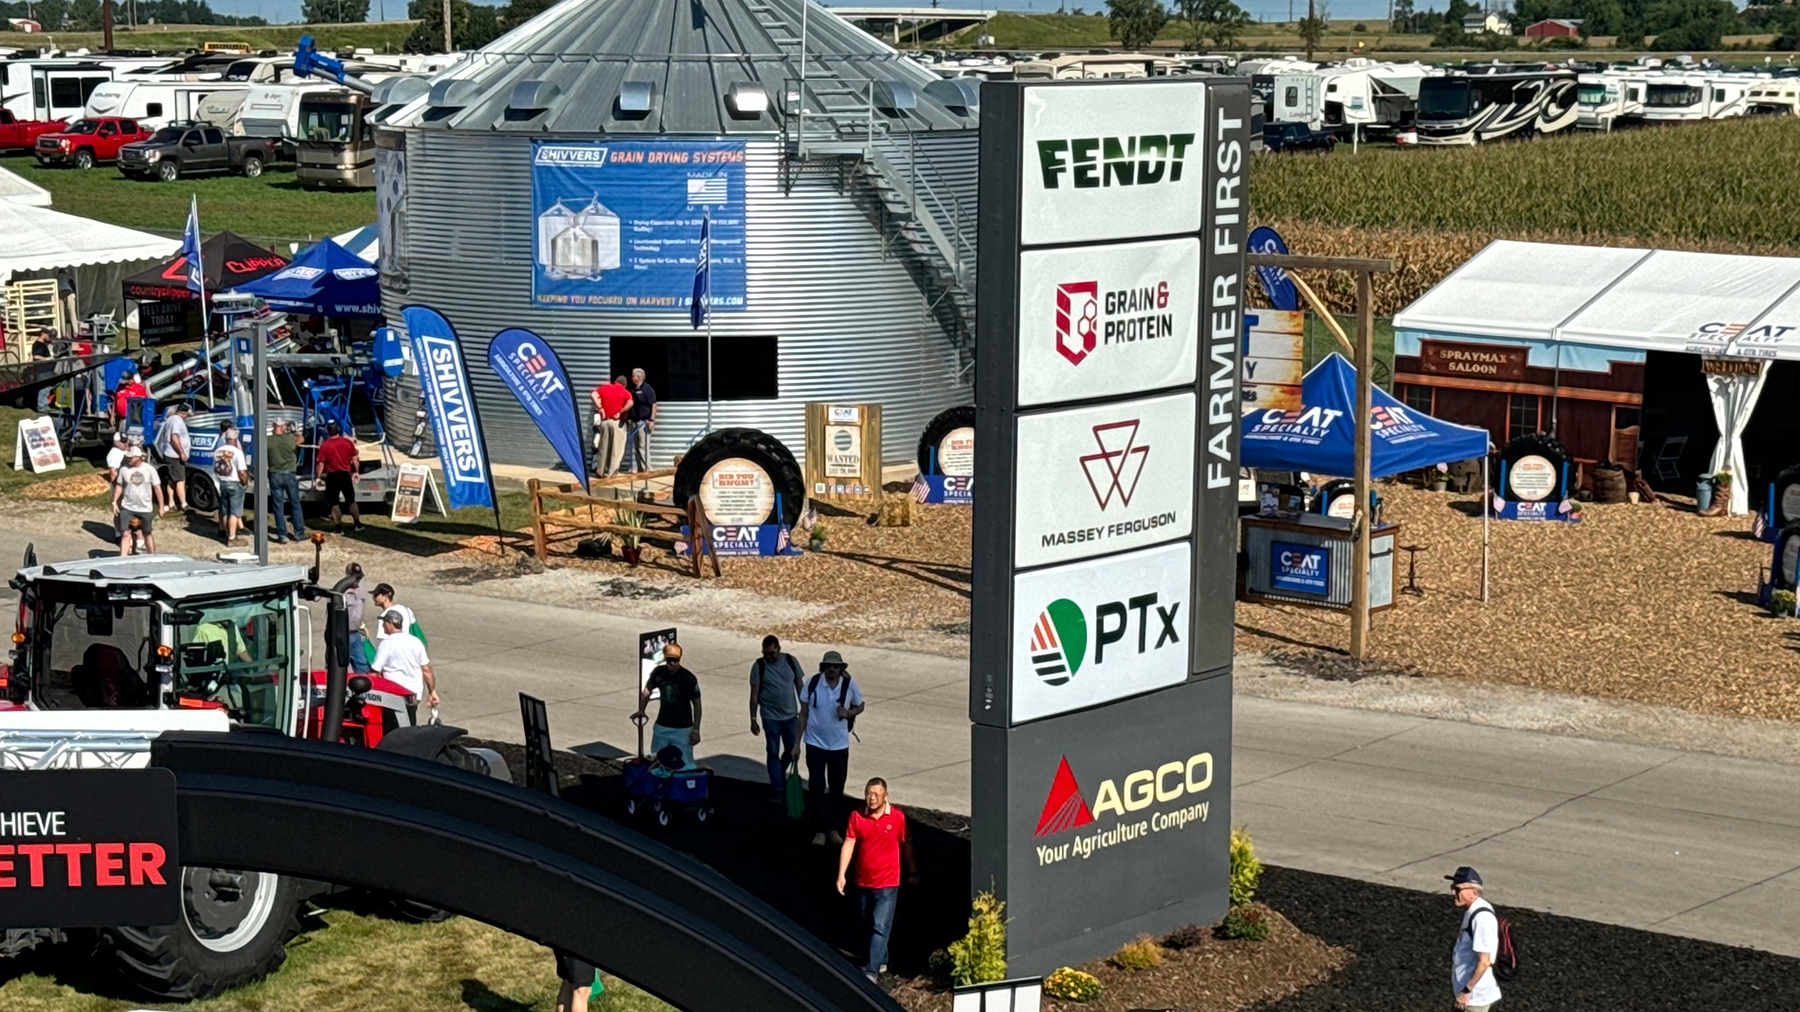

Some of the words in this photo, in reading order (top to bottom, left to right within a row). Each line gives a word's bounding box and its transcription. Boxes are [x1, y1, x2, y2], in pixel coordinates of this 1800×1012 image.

[541, 149, 600, 161] SHIVVERS
[610, 151, 644, 163] GRAIN
[648, 151, 688, 163] DRYING
[692, 151, 744, 163] SYSTEMS
[1036, 133, 1195, 189] FENDT
[1214, 107, 1242, 255] FIRST
[225, 256, 287, 273] CLIPPER
[537, 295, 568, 303] KEEPING
[570, 295, 586, 304] YOU
[588, 296, 623, 304] FOCUSED
[626, 296, 636, 304] ON
[639, 296, 676, 305] HARVEST
[142, 304, 159, 316] TEST
[161, 302, 182, 314] DRIVE
[151, 314, 174, 325] TODAY
[1104, 313, 1173, 345] PROTEIN
[1699, 322, 1797, 337] CEAT
[1440, 350, 1507, 363] SPRAYMAX
[508, 352, 549, 401] SPECIALTY
[517, 342, 565, 395] CEAT
[1448, 362, 1497, 374] SALOON
[1207, 273, 1238, 489] FARMER
[432, 347, 477, 472] SHIVVERS
[1262, 406, 1343, 429] CEAT
[1251, 424, 1330, 438] SPECIALTY
[1375, 424, 1429, 438] SPECIALTY
[826, 455, 859, 463] WANTED
[1517, 502, 1547, 511] CEAT
[713, 527, 759, 541] CEAT
[1041, 526, 1105, 548] MASSEY
[1107, 511, 1176, 538] FERGUSON
[1281, 551, 1321, 569] CEAT
[1281, 566, 1320, 577] SPECIALTY
[1095, 592, 1180, 665] PTx
[1092, 752, 1213, 820] AGCO
[1, 811, 66, 836] HIEVE
[1036, 843, 1069, 866] Your
[1072, 819, 1148, 860] Agriculture
[1152, 801, 1209, 832] Company
[0, 842, 167, 887] ETTER
